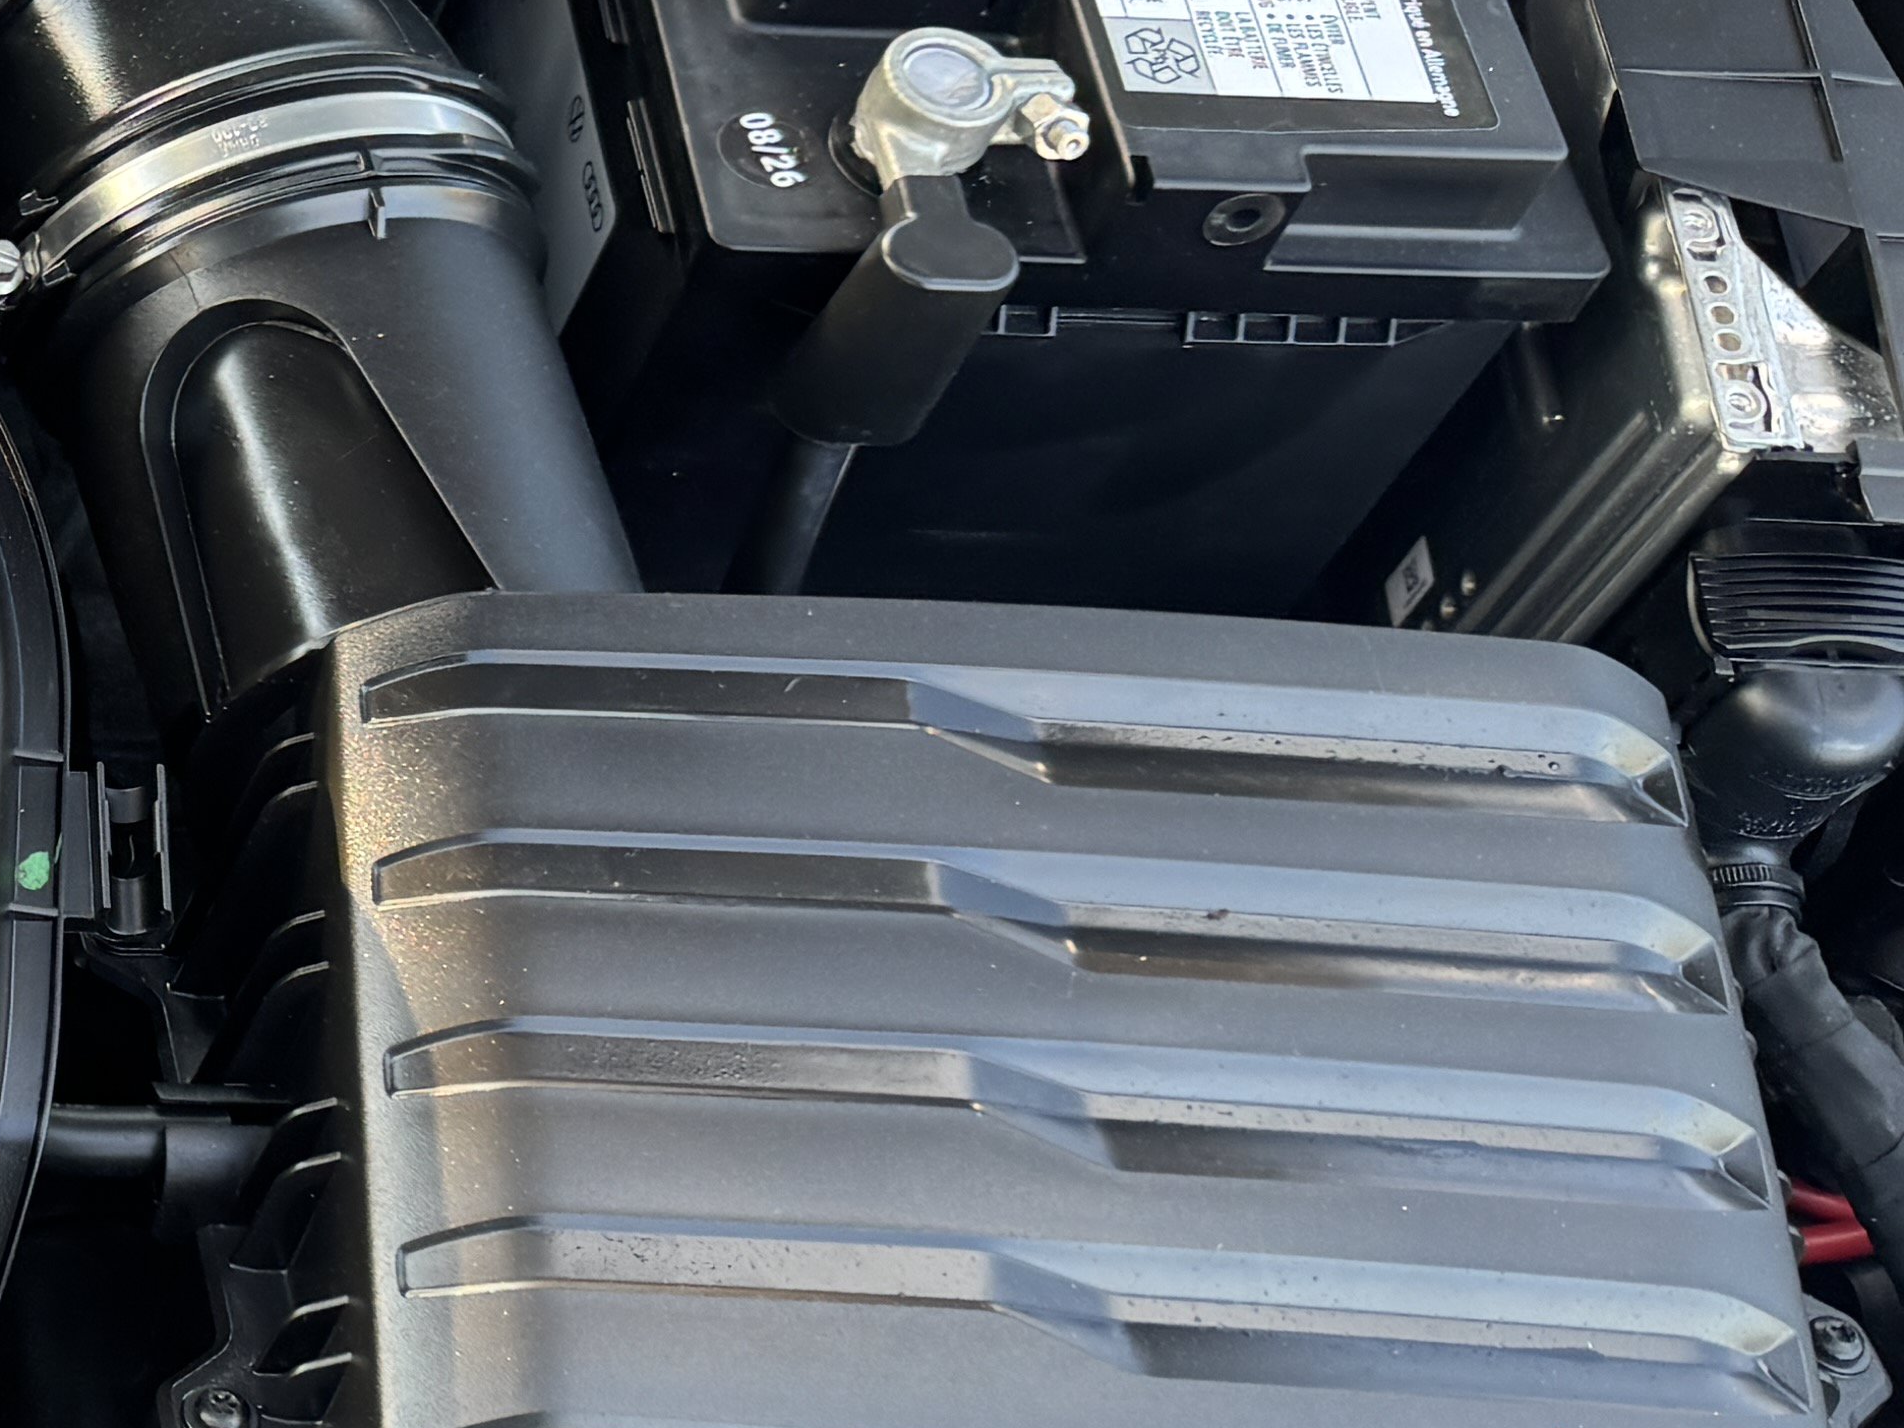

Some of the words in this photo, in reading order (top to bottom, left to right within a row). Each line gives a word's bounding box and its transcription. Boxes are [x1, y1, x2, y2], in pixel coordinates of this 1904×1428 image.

[1213, 10, 1236, 32] DOIT
[1233, 11, 1253, 23] LA
[1264, 23, 1284, 34] DE
[1284, 23, 1305, 39] LES
[1304, 23, 1325, 40] LES
[1413, 30, 1435, 47] en
[1238, 26, 1269, 70] BATTERIE
[1270, 37, 1296, 68] FUMER
[1291, 42, 1322, 87] FLAMMES
[1310, 43, 1346, 93] ÉTINCELLES
[1417, 49, 1465, 117] Allemagne
[737, 104, 808, 194] 08/26
